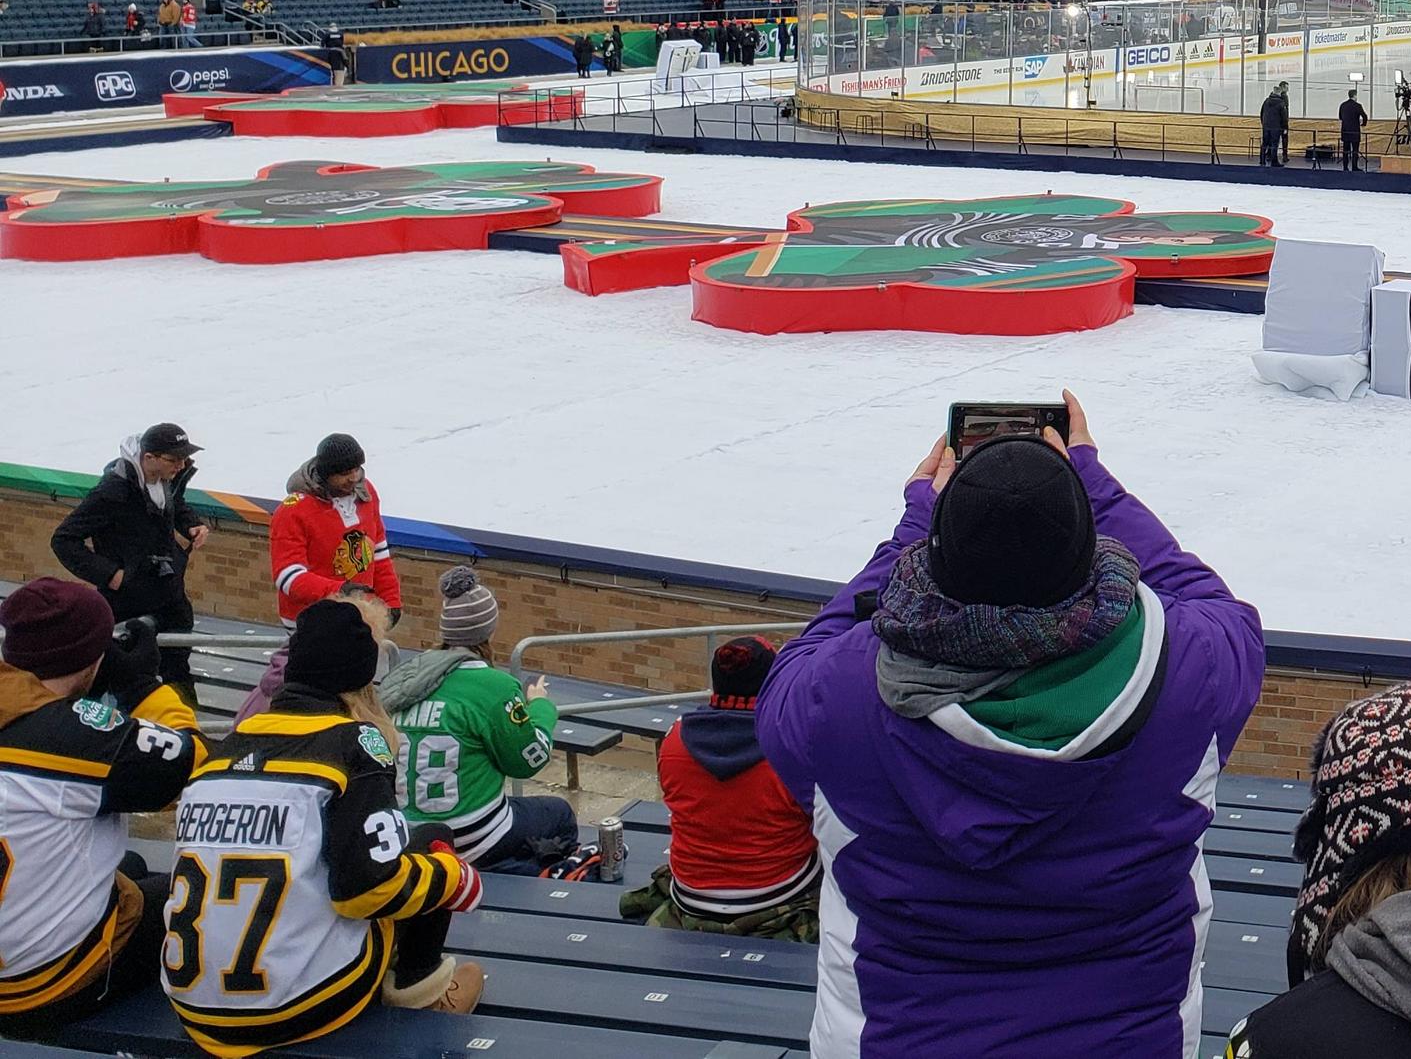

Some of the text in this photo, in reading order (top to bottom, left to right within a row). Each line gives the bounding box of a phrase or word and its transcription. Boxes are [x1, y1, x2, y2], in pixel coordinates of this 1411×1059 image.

[1314, 31, 1348, 45] ticketmaster
[392, 48, 509, 79] CHICAGO
[1127, 46, 1171, 66] GEICO
[193, 67, 231, 86] pepsi
[919, 67, 982, 87] BRIDGESTONE
[1025, 59, 1044, 76] SAP
[98, 74, 134, 97] PPG
[841, 76, 884, 93] FISHERMAN'S
[177, 802, 289, 846] BERGERON
[161, 851, 292, 995] 37
